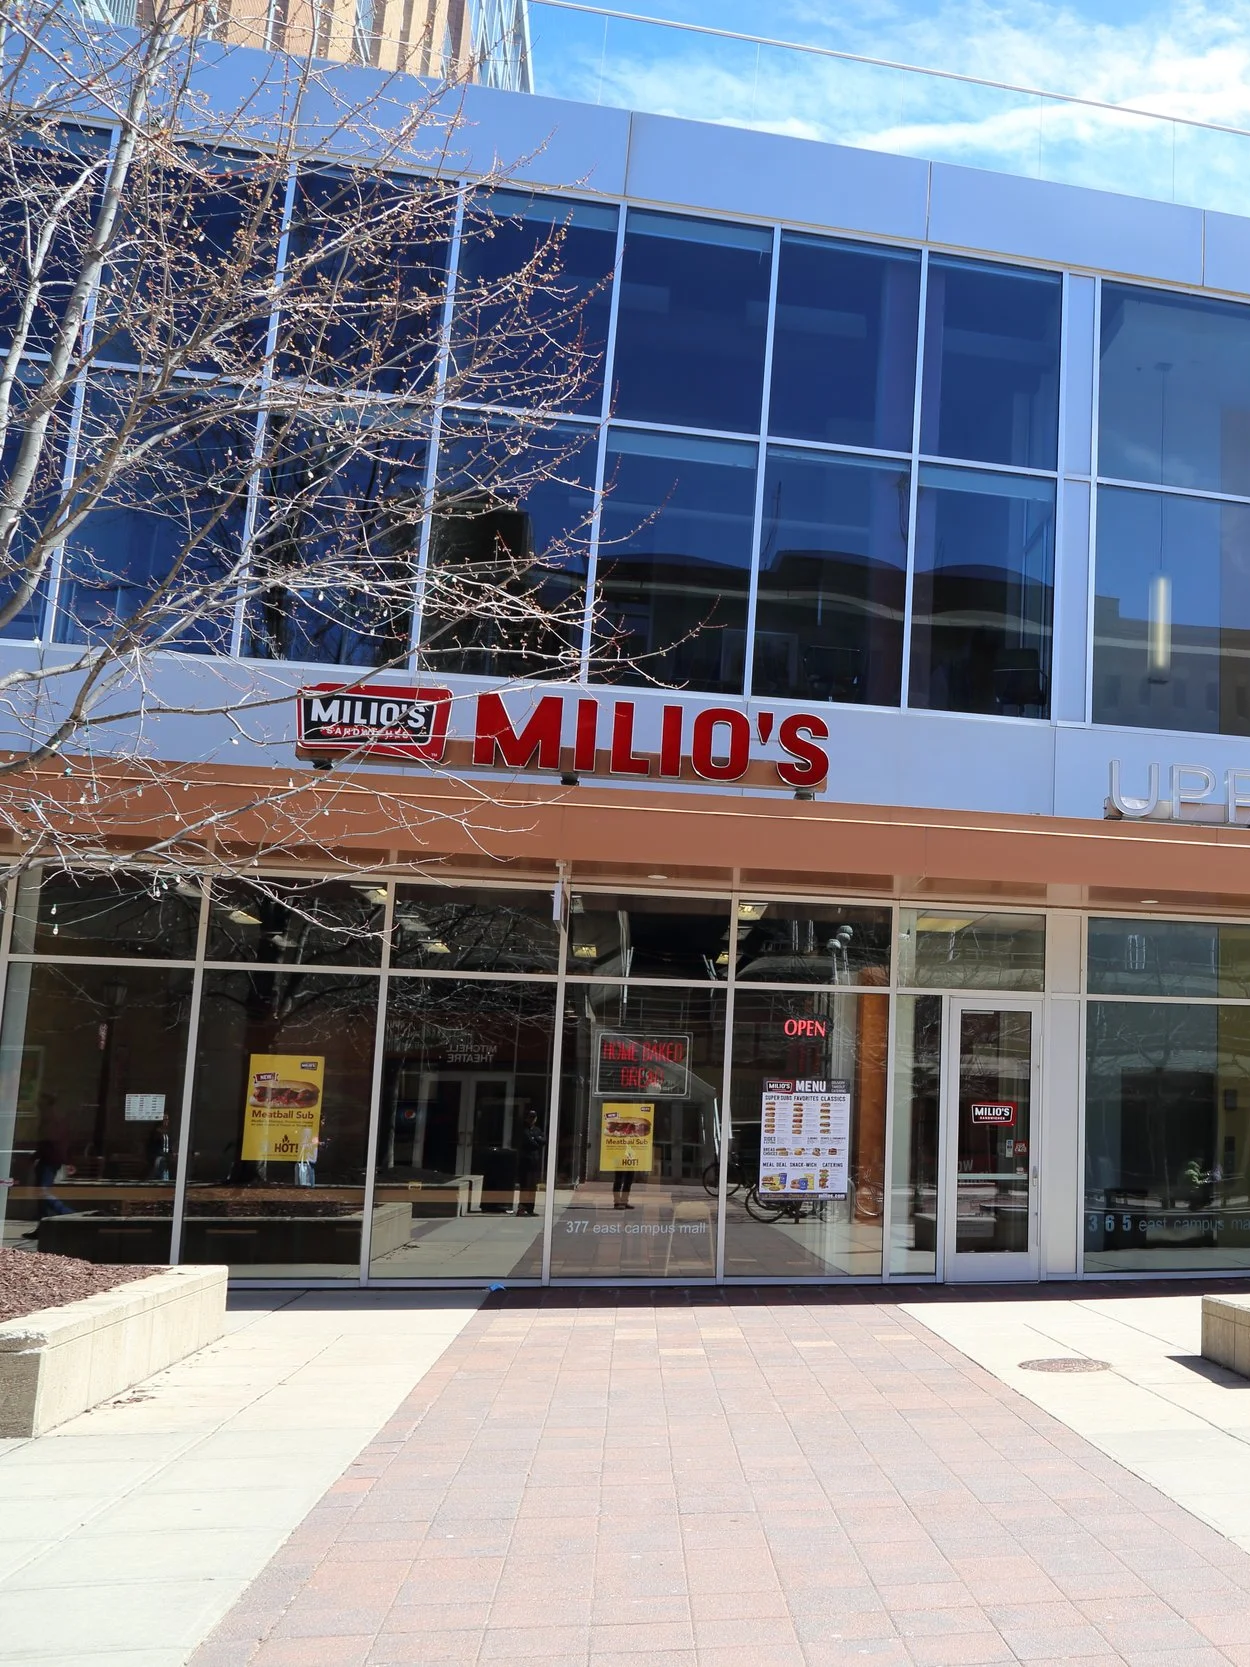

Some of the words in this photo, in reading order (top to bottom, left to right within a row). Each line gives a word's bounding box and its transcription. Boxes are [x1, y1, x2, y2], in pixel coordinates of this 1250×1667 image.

[311, 698, 426, 729] MILIO'S
[473, 693, 830, 788] MILIO'S
[784, 1018, 827, 1038] OPEN
[795, 1080, 827, 1093] MENU
[252, 1109, 293, 1118] Meatball
[296, 1111, 314, 1119] Sub
[975, 1107, 1010, 1116] MILIO'S
[274, 1143, 299, 1153] HOT!
[566, 1221, 589, 1234] 377
[593, 1223, 621, 1234] east
[624, 1223, 676, 1236] campus
[679, 1222, 706, 1234] mall
[1138, 1218, 1167, 1232] east
[1173, 1218, 1225, 1233] campus
